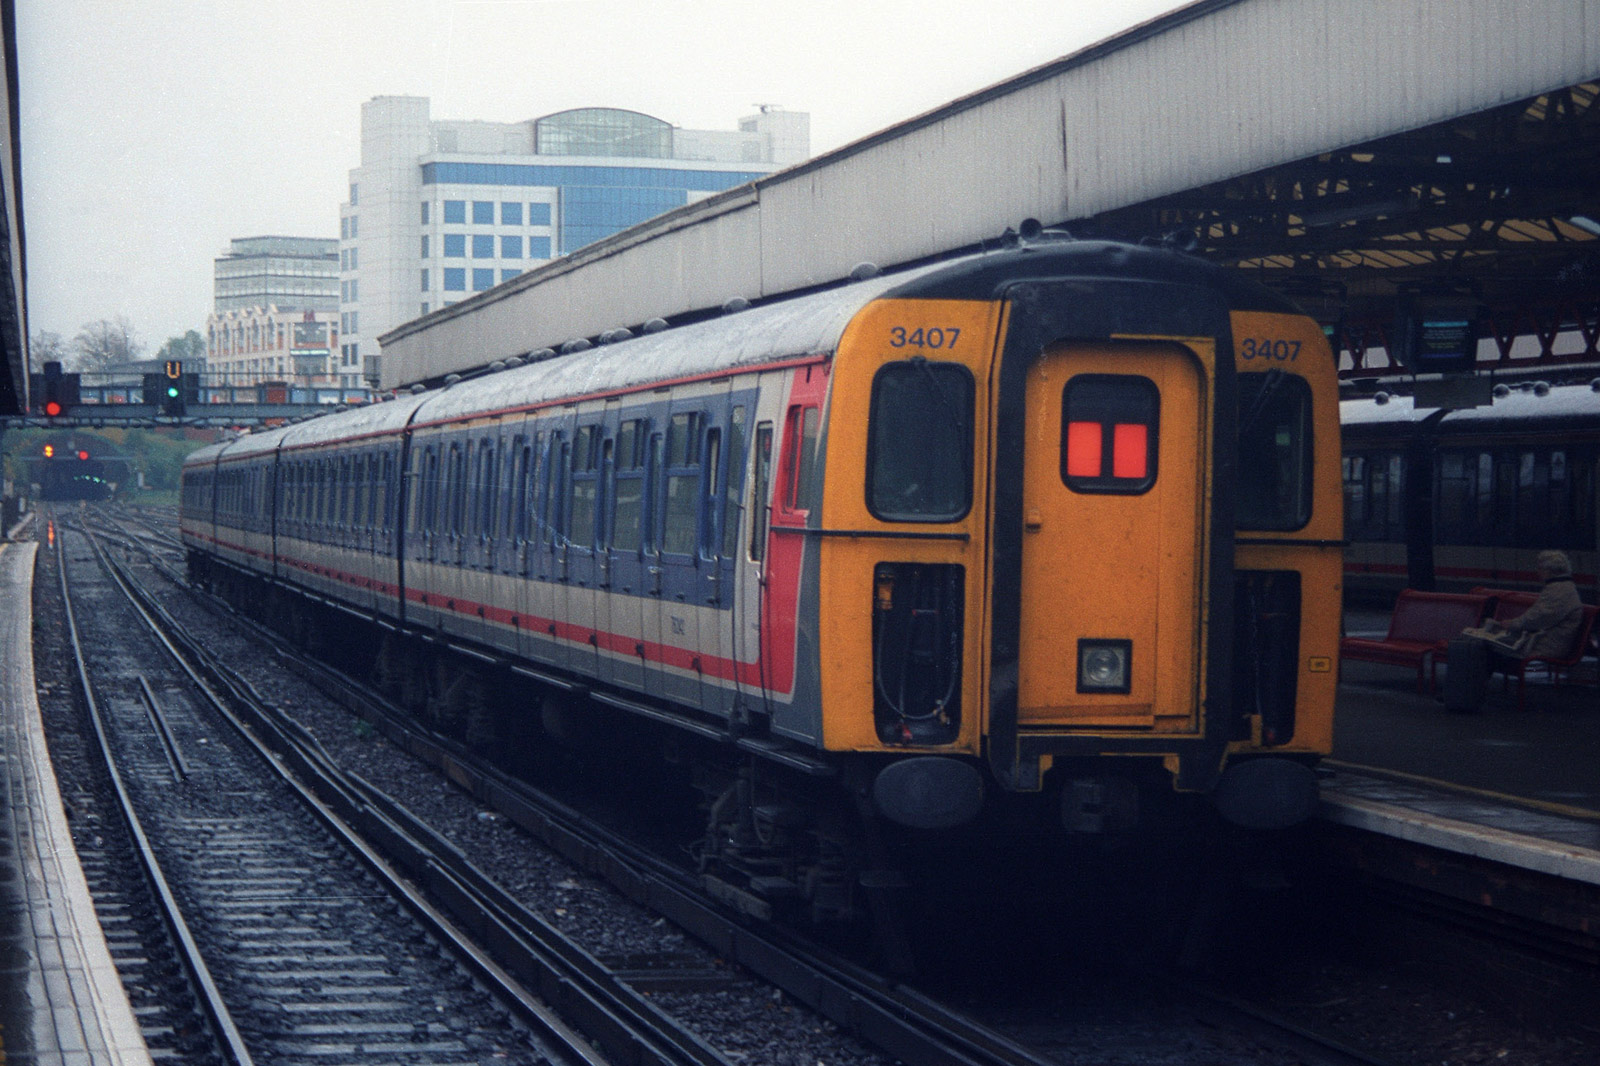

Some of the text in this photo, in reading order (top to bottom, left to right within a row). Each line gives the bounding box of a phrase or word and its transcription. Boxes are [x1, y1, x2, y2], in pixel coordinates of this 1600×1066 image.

[890, 326, 961, 349] 3407
[1241, 338, 1302, 362] 3407
[167, 361, 180, 379] U
